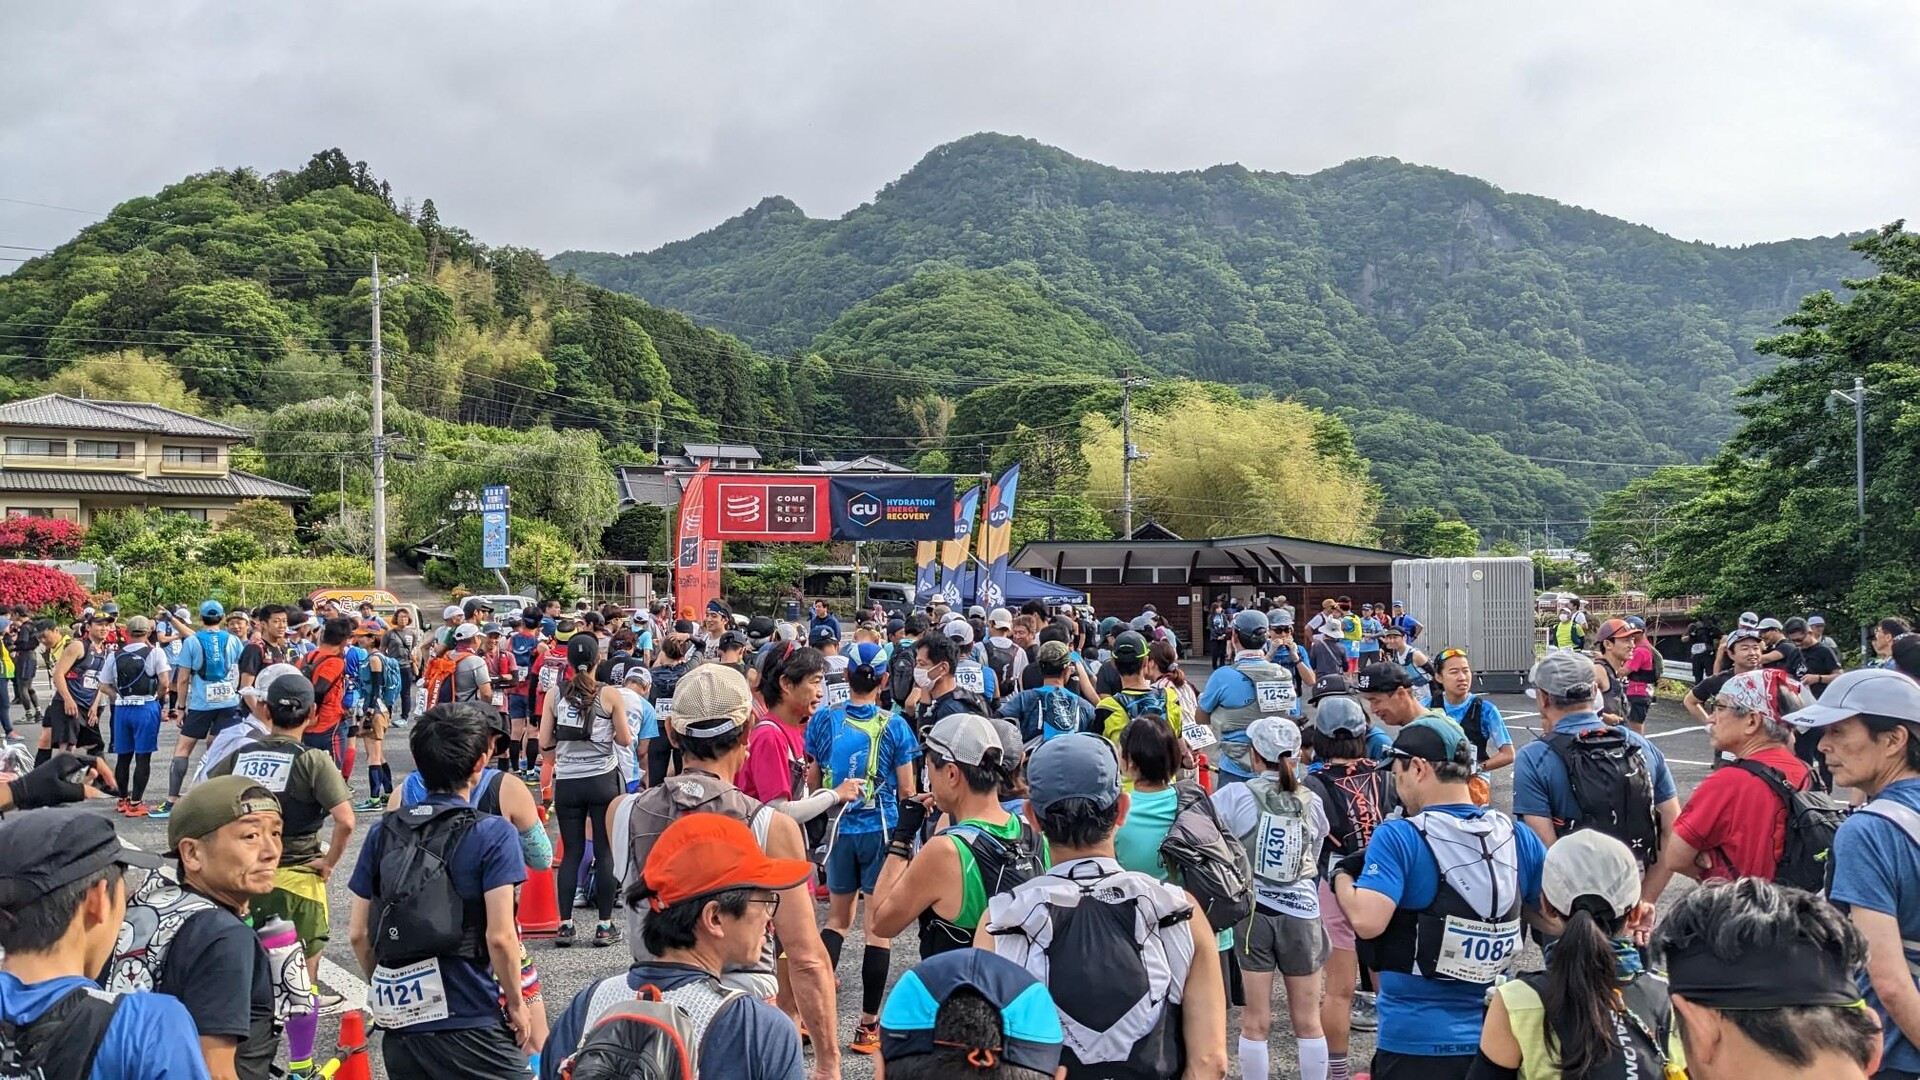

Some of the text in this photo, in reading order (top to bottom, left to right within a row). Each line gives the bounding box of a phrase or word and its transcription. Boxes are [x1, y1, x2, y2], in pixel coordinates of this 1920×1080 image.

[851, 503, 877, 516] GU
[213, 687, 231, 696] 1339
[1263, 689, 1290, 701] 1245
[1185, 725, 1207, 741] 1450
[243, 761, 281, 778] 1387
[1266, 828, 1286, 867] 1430
[1461, 937, 1514, 962] 1082
[375, 980, 424, 1007] 1121
